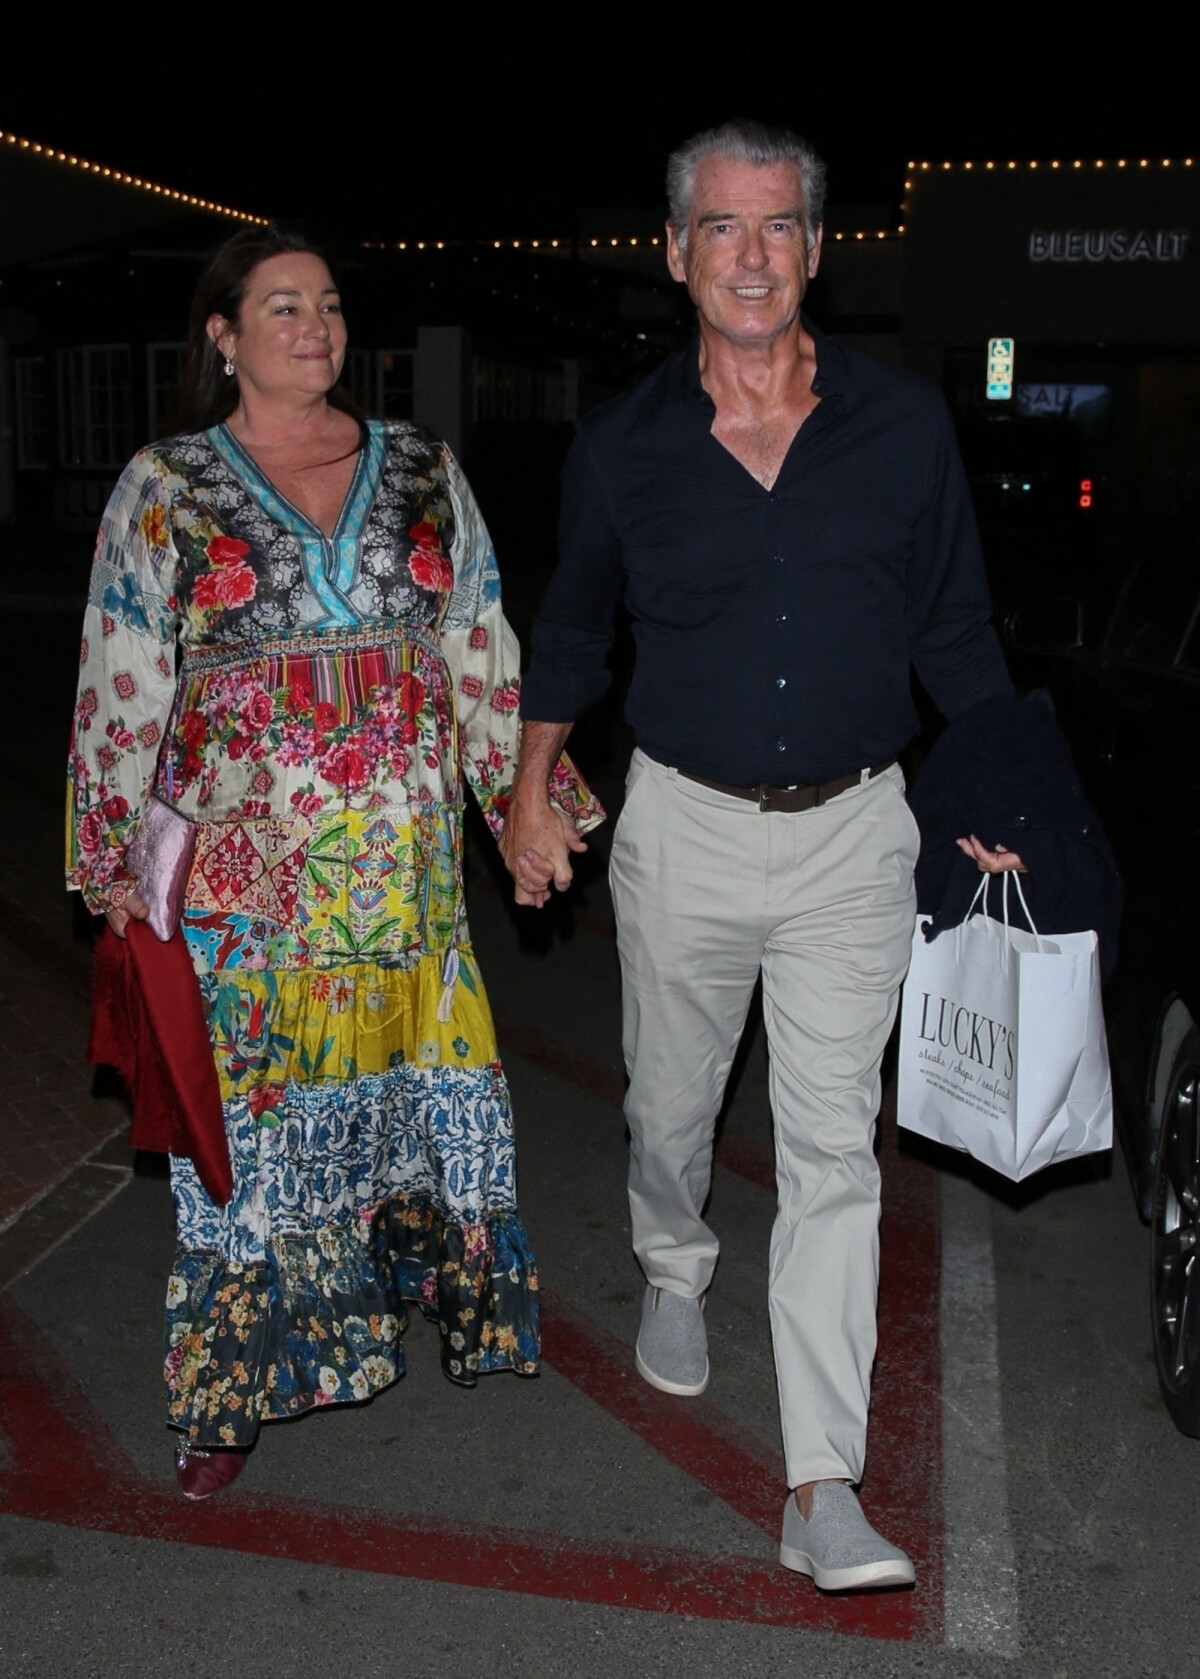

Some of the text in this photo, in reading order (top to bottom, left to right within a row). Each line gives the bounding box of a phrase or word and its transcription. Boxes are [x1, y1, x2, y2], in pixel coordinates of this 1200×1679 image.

[1029, 230, 1189, 261] BLEUSALT
[918, 992, 1015, 1081] LUCKY'S
[918, 1048, 946, 1067] steaks
[954, 1060, 974, 1084] chops
[982, 1079, 1011, 1101] seafood
